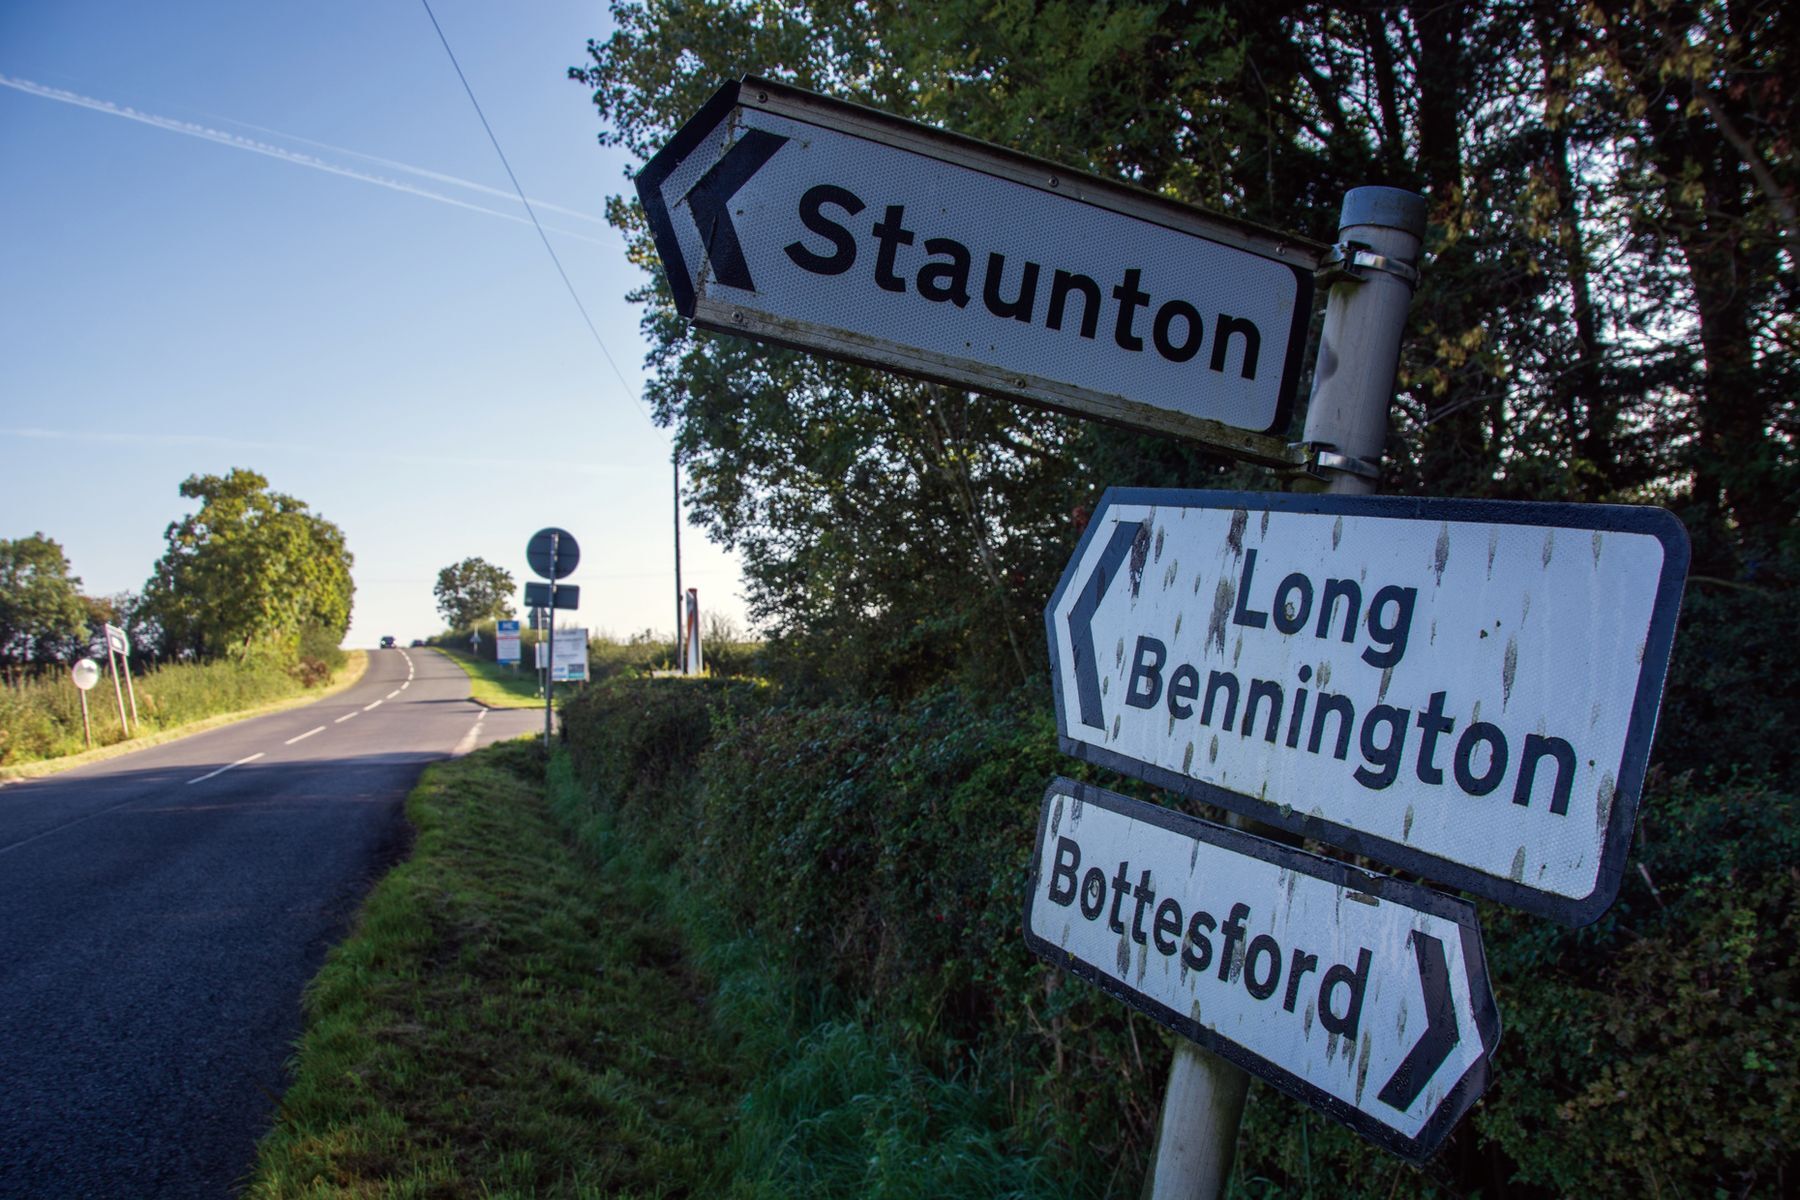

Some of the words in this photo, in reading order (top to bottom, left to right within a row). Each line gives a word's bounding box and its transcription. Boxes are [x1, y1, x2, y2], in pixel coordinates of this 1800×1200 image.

[784, 184, 1261, 380] Staunton
[1233, 548, 1417, 668] Long
[1125, 635, 1577, 816] Bennington
[1048, 836, 1372, 1041] Bottesford
